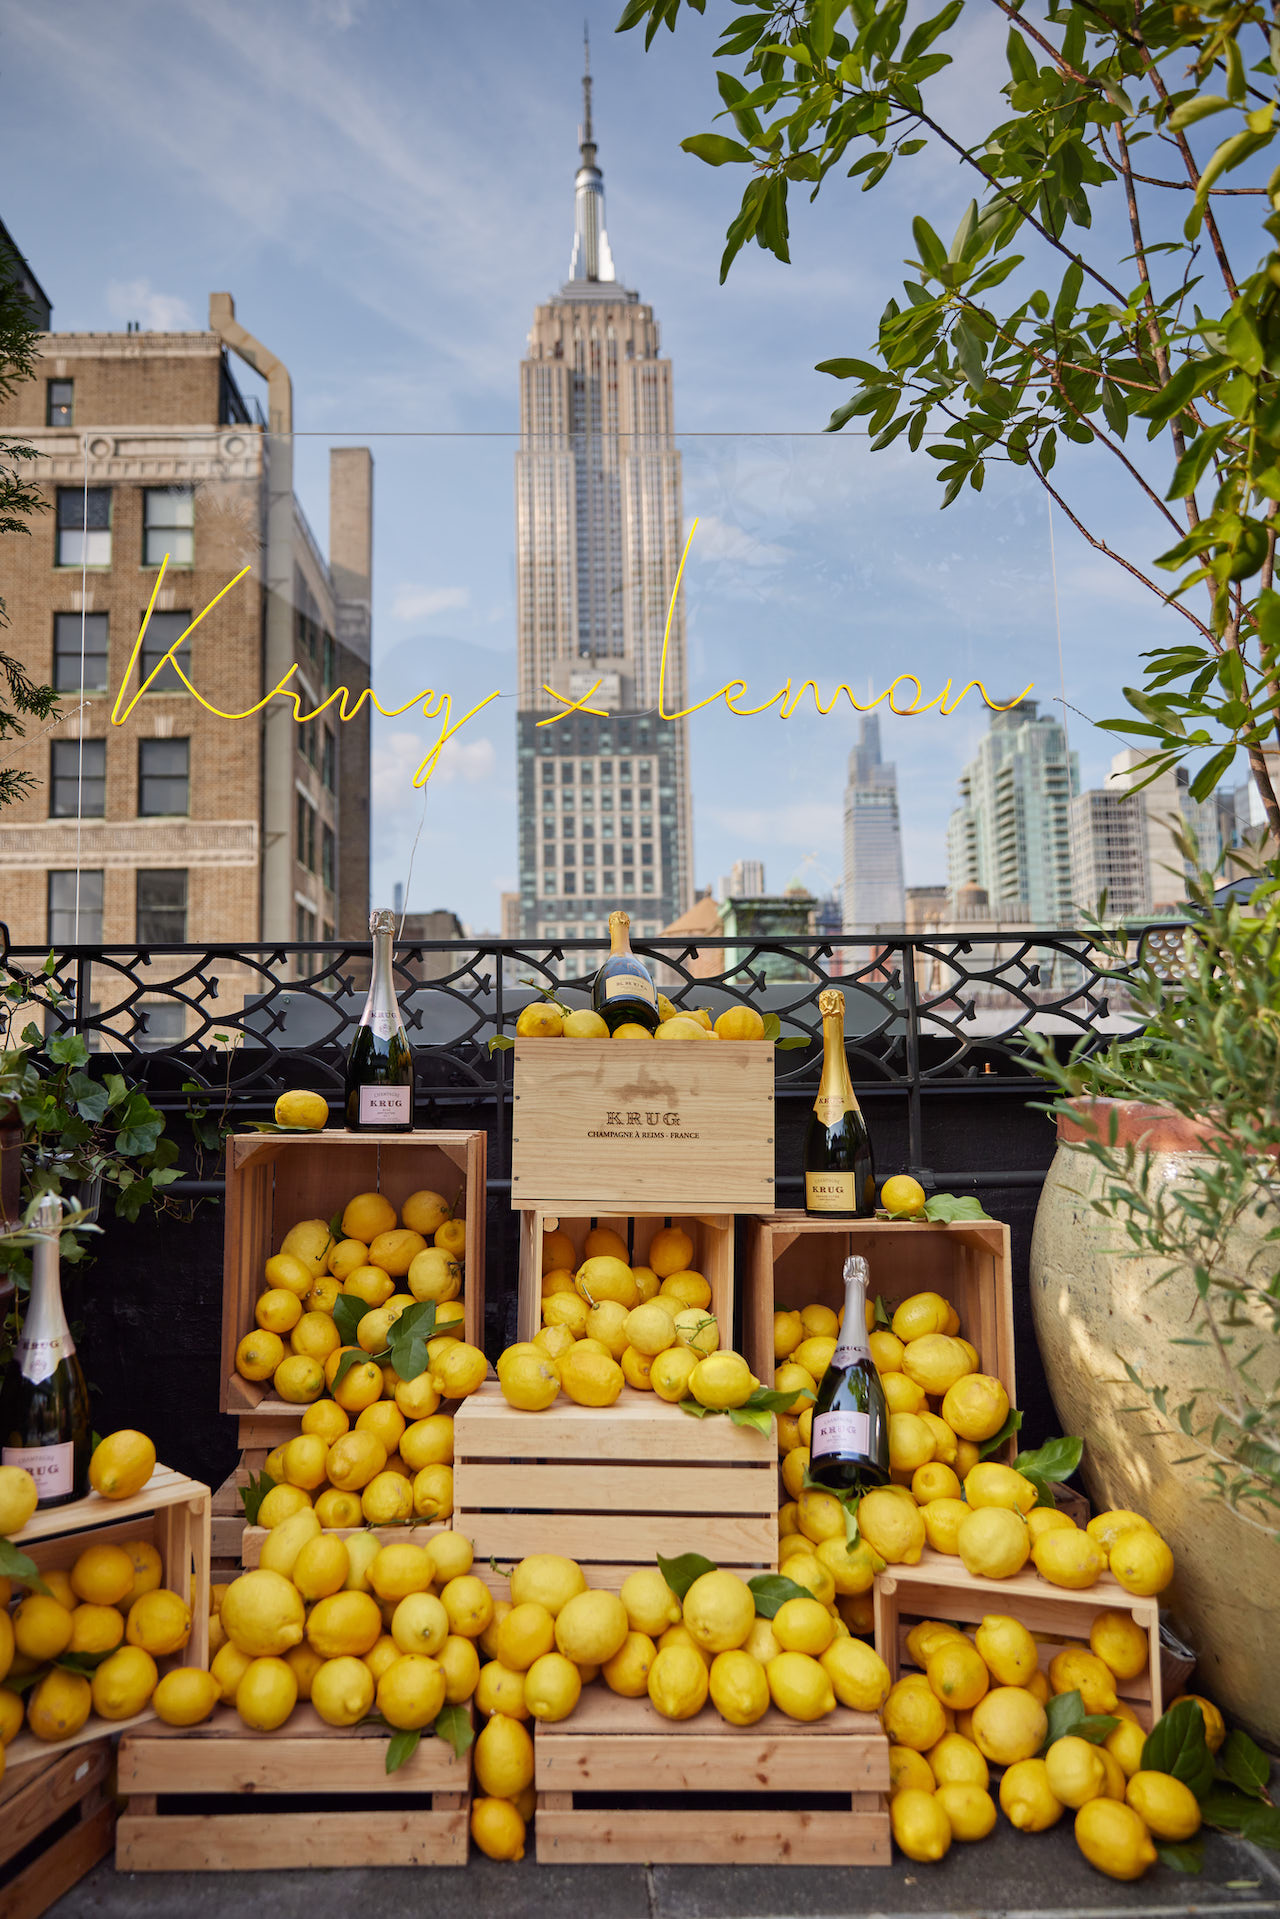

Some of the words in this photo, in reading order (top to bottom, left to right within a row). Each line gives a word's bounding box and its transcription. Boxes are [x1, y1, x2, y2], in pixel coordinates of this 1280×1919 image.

[110, 552, 501, 789] Krug
[818, 1097, 845, 1105] KRUG
[606, 1111, 681, 1126] KRUG
[812, 1185, 844, 1193] KRUG
[23, 1339, 59, 1350] KRUG
[820, 1426, 856, 1436] KRUG
[24, 1464, 59, 1477] RUG
